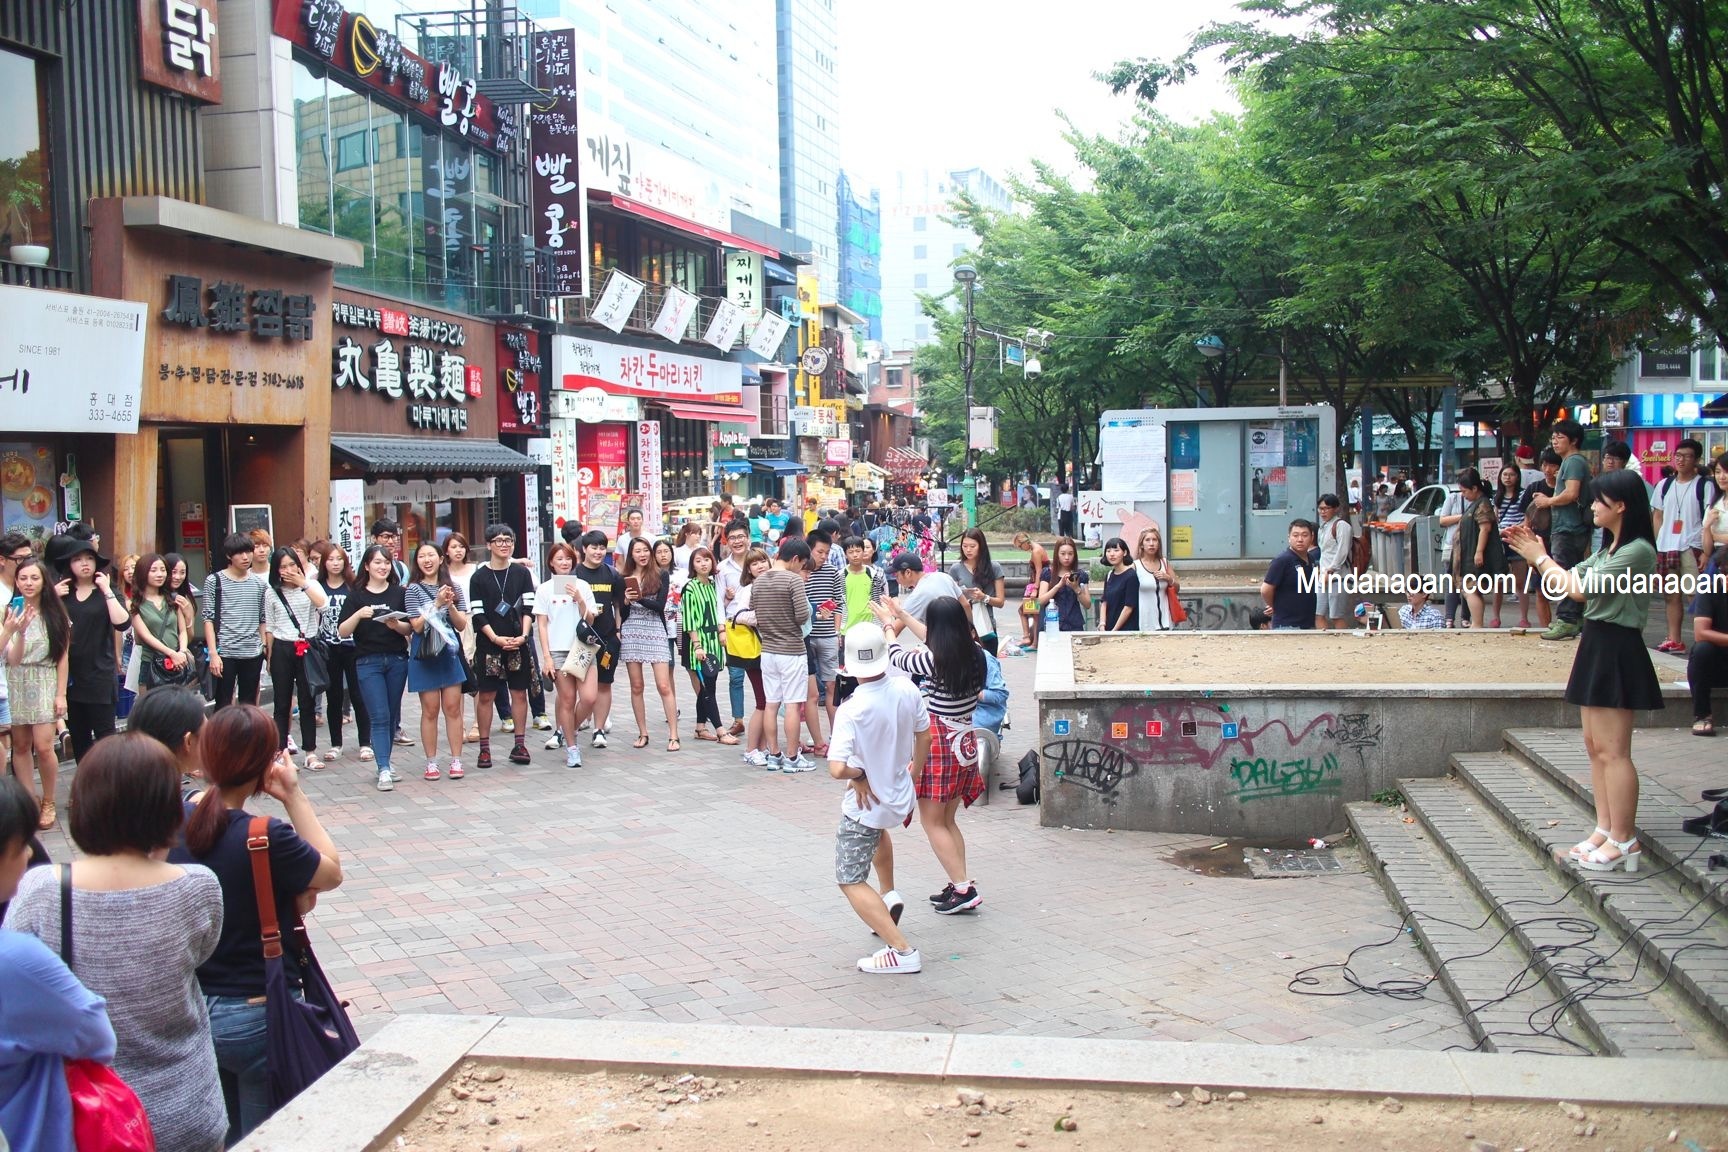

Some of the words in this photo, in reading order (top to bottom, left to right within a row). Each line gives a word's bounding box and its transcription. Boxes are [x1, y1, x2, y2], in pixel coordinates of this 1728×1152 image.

[314, 33, 335, 59] 카페
[545, 62, 569, 76] 카페
[19, 344, 42, 355] SINCE
[45, 346, 61, 356] 1981
[336, 337, 467, 404] 丸亀製麺
[88, 409, 132, 422] 333-4655
[719, 431, 738, 447] Apple
